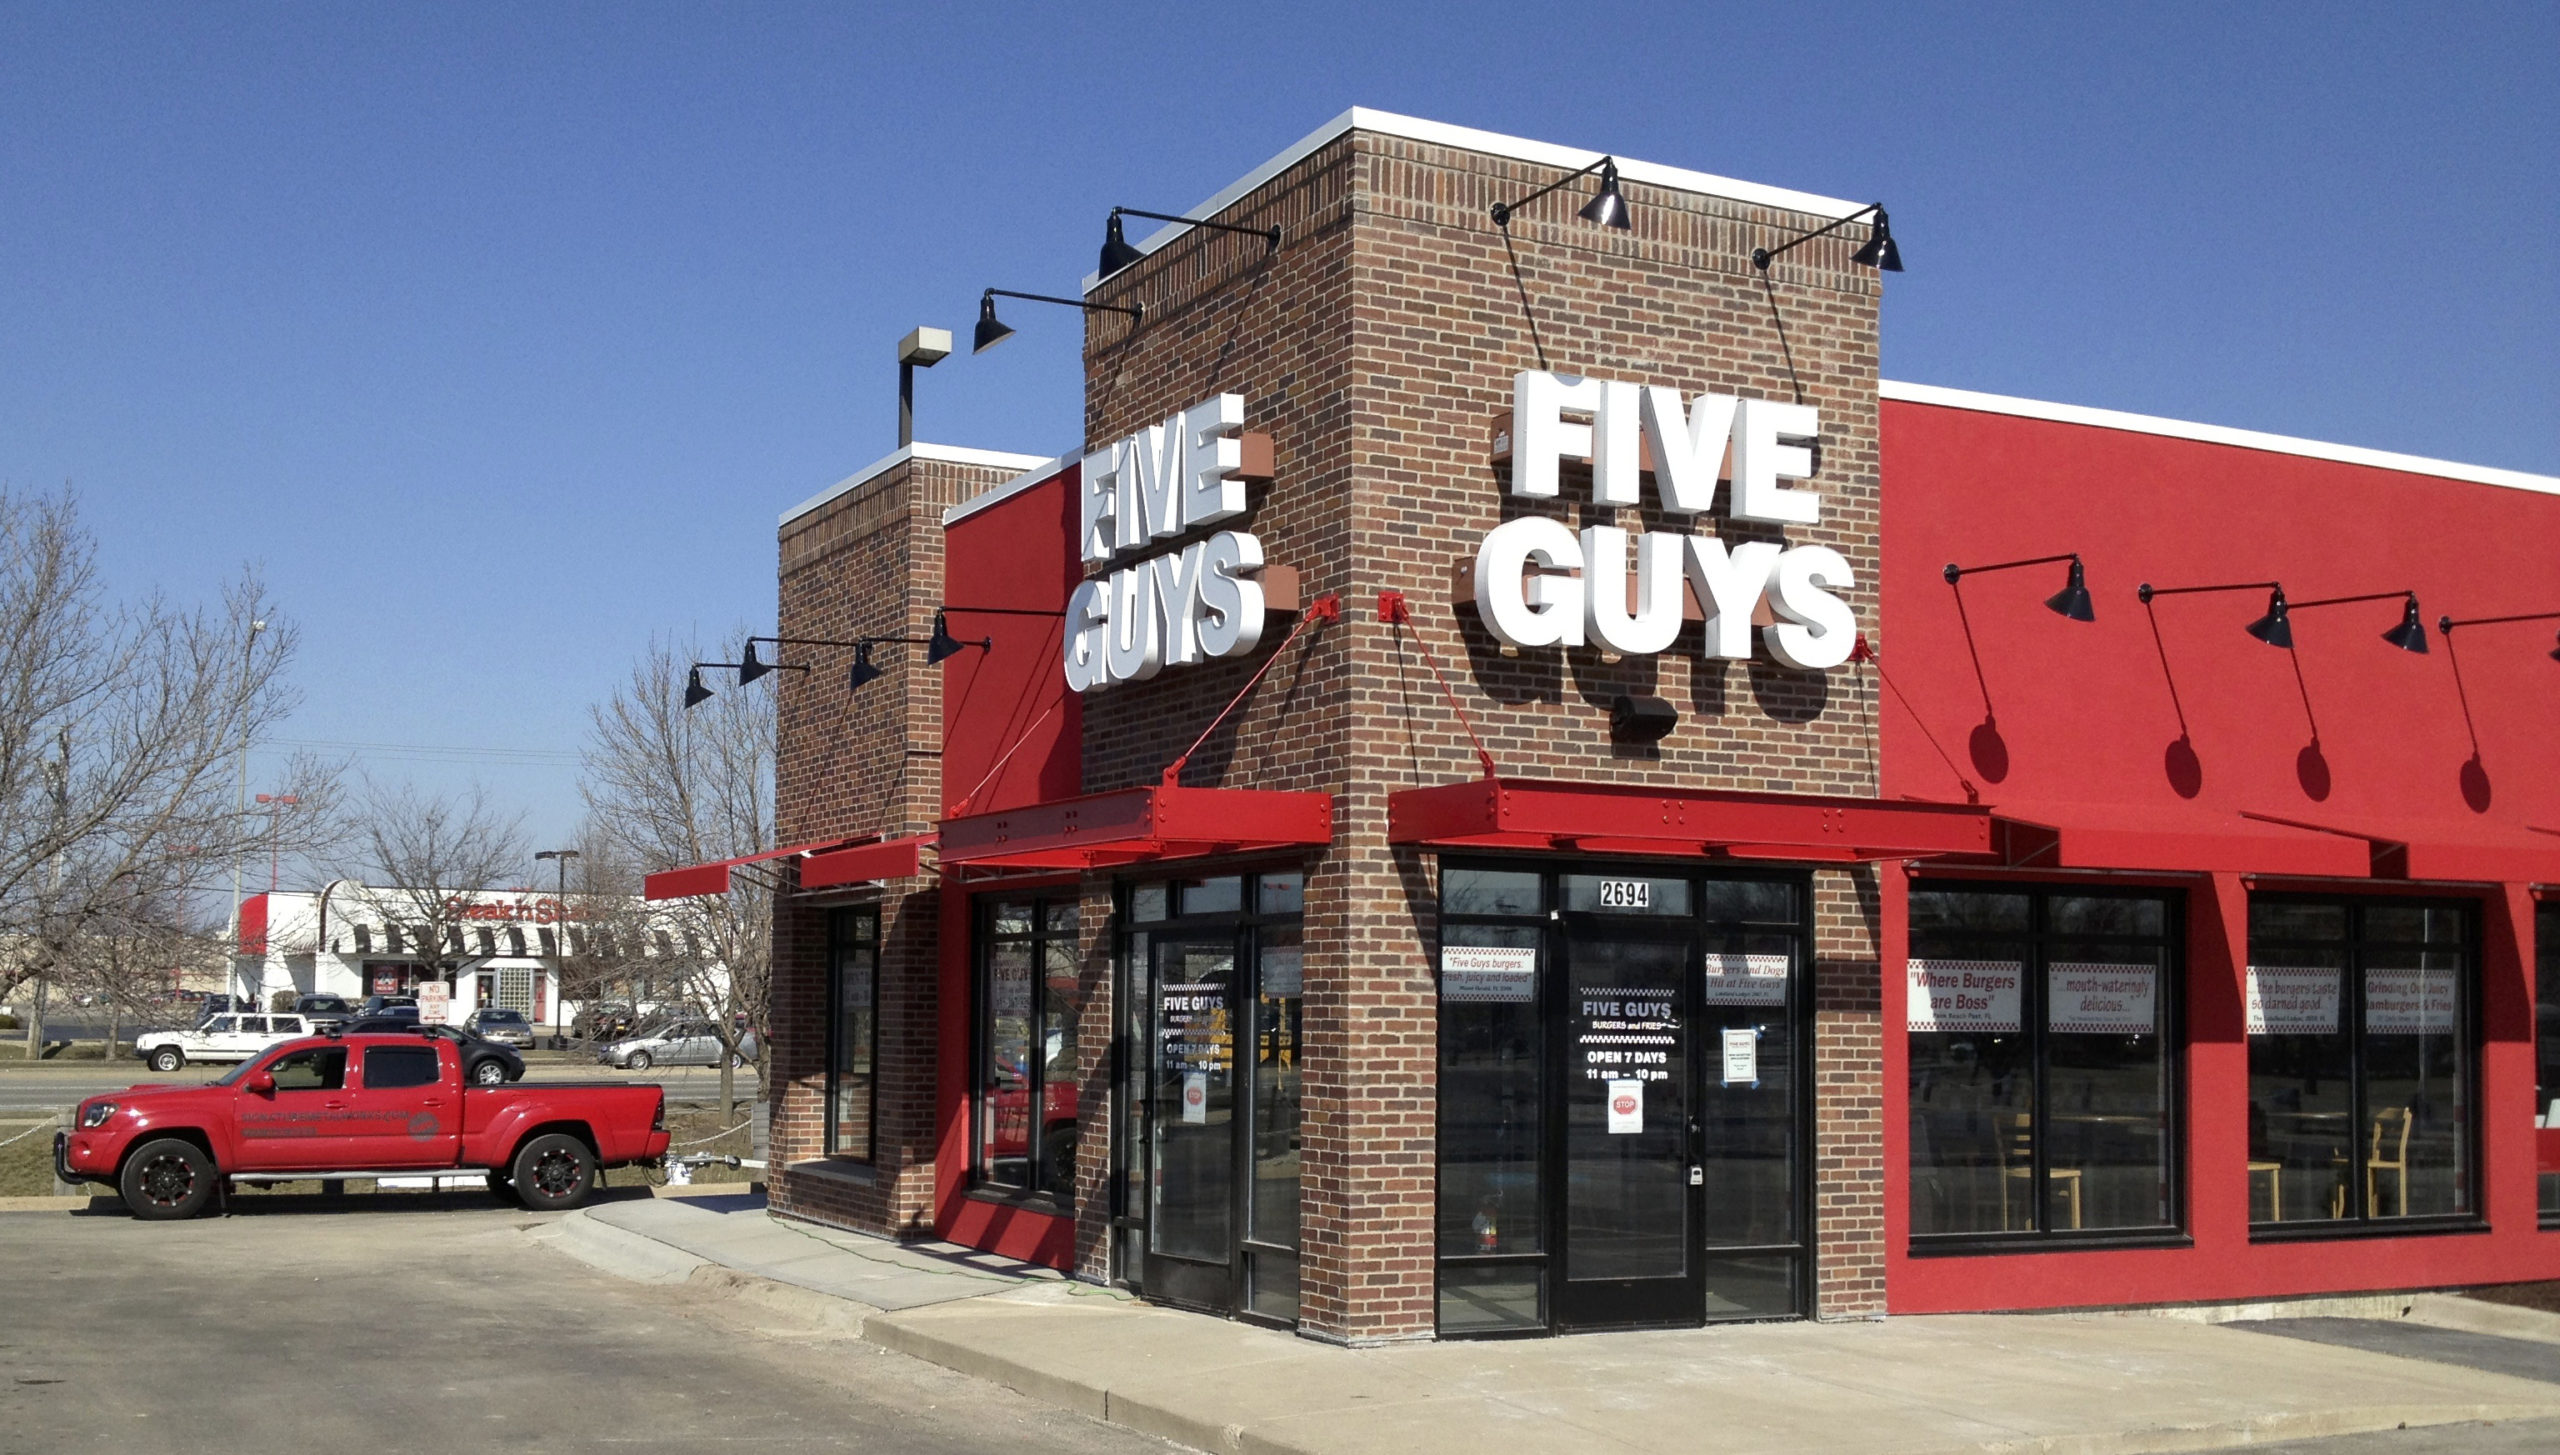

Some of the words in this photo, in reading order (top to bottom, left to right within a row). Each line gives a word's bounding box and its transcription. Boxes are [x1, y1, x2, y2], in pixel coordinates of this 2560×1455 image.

[1512, 369, 1820, 524] FIVE
[1081, 392, 1247, 562] FIVE
[1474, 516, 1857, 669] GUYS
[1064, 530, 1265, 693] GUYS
[1602, 882, 1647, 906] 2694
[1470, 958, 1490, 970] Guys
[1706, 964, 1740, 976] Burgers
[1742, 964, 1761, 975] and
[1763, 965, 1785, 976] Dogs
[1465, 972, 1484, 984] juicy
[1486, 973, 1500, 982] and
[1710, 978, 1724, 988] Hit
[1726, 979, 1737, 988] at
[1738, 978, 1757, 989] Five
[1910, 971, 1959, 988] "Where
[1962, 972, 2016, 993] Burgers
[428, 984, 441, 994] NO
[2275, 980, 2311, 998] burgers
[2312, 981, 2337, 995] taste
[421, 994, 449, 1002] PARKING
[1164, 996, 1189, 1011] FIVE
[1191, 996, 1224, 1011] GUYS
[1930, 996, 1952, 1009] are
[1956, 993, 1995, 1010] Boss"
[2251, 999, 2264, 1010] so
[2265, 995, 2298, 1010] darned
[1582, 1001, 1620, 1016] FIVE
[1625, 1001, 1672, 1017] GUYS
[1592, 1021, 1627, 1029] BURGERS
[1627, 1022, 1641, 1030] and
[1641, 1022, 1662, 1030] FRIES
[1166, 1043, 1189, 1054] OPEN
[1198, 1043, 1220, 1055] DAYS
[1587, 1051, 1622, 1063] OPEN
[1624, 1051, 1632, 1063] 7
[1634, 1052, 1667, 1064] DAYS
[1166, 1060, 1174, 1069] 11
[1175, 1061, 1188, 1069] am
[1198, 1060, 1208, 1070] 10
[1208, 1062, 1221, 1072] pm
[1586, 1068, 1598, 1079] 11
[1601, 1070, 1619, 1079] am
[1635, 1068, 1649, 1079] 10
[1650, 1071, 1668, 1081] pm
[1616, 1101, 1636, 1109] STOP
